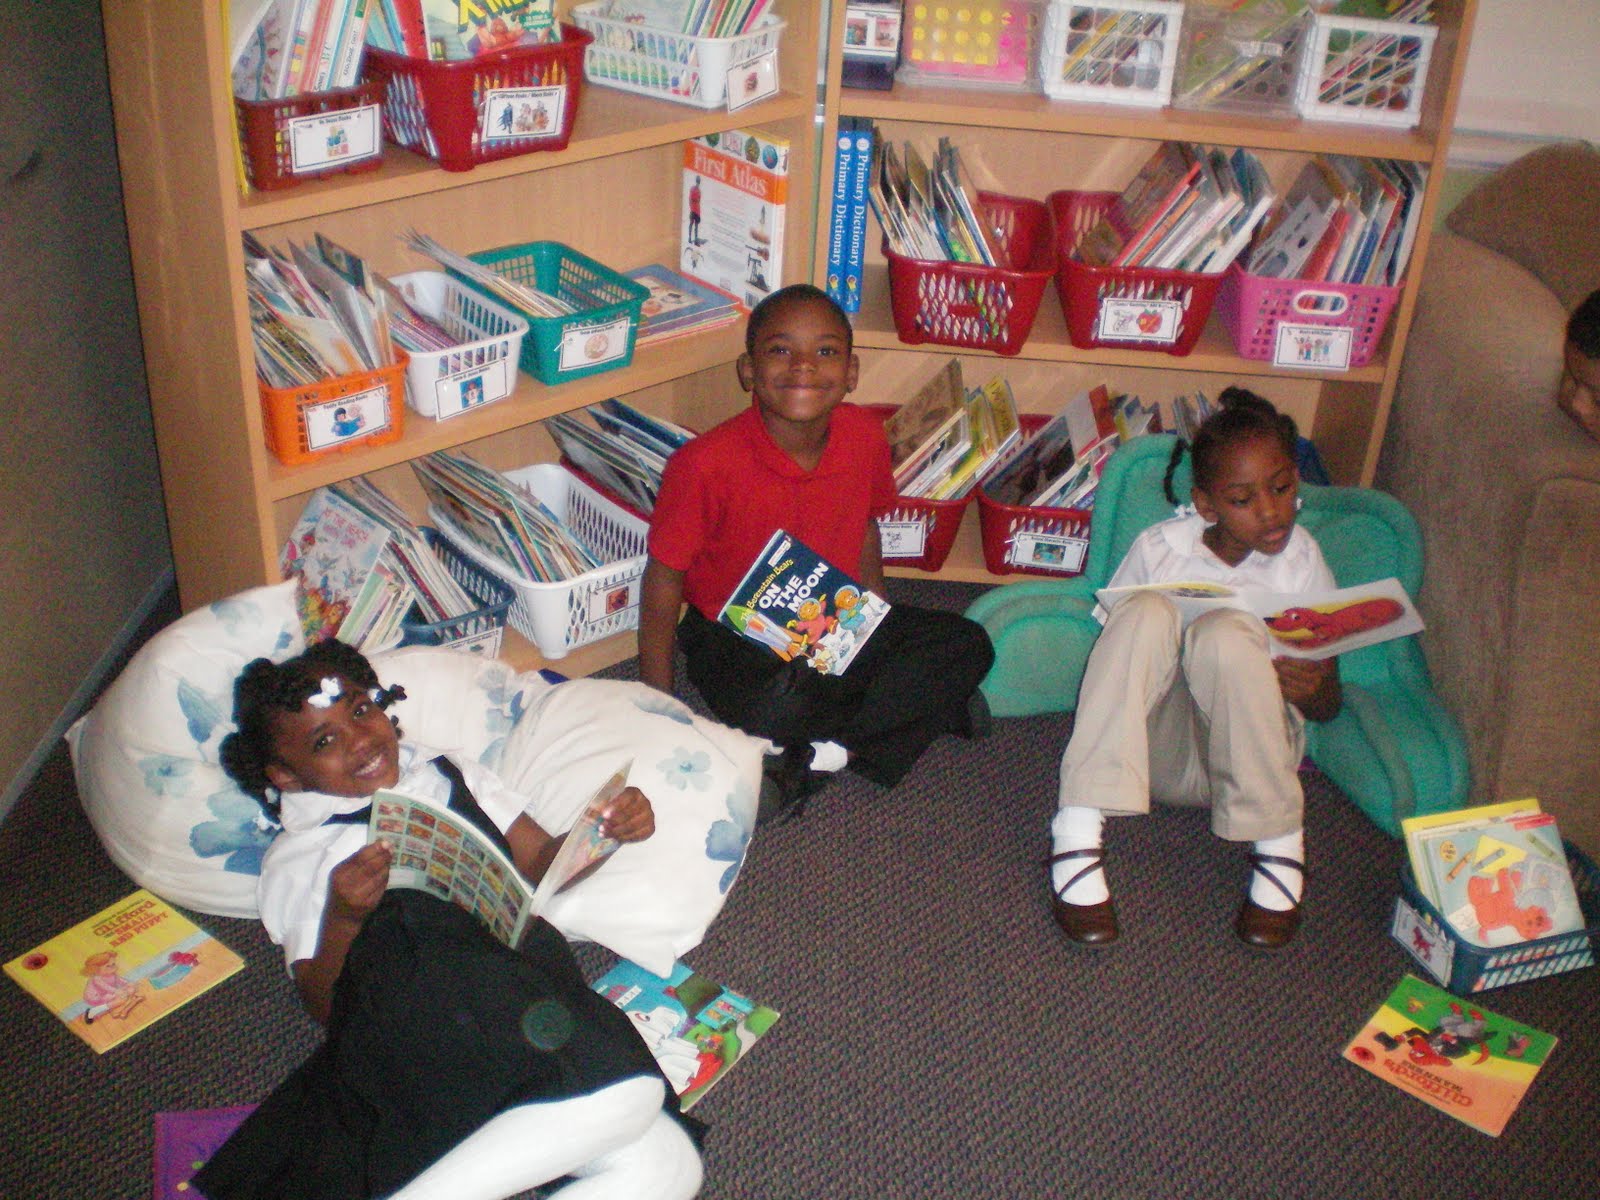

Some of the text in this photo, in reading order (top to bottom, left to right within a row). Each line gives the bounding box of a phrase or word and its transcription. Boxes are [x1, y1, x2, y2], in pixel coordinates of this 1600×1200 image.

[694, 147, 767, 196] First Atlas
[829, 153, 851, 267] Primary Dictionary
[849, 154, 869, 267] Primary Dictionary
[746, 572, 776, 610] Berenstain
[773, 558, 795, 577] Bears
[758, 582, 783, 609] ON
[772, 574, 803, 609] THE
[786, 561, 829, 614] MOON
